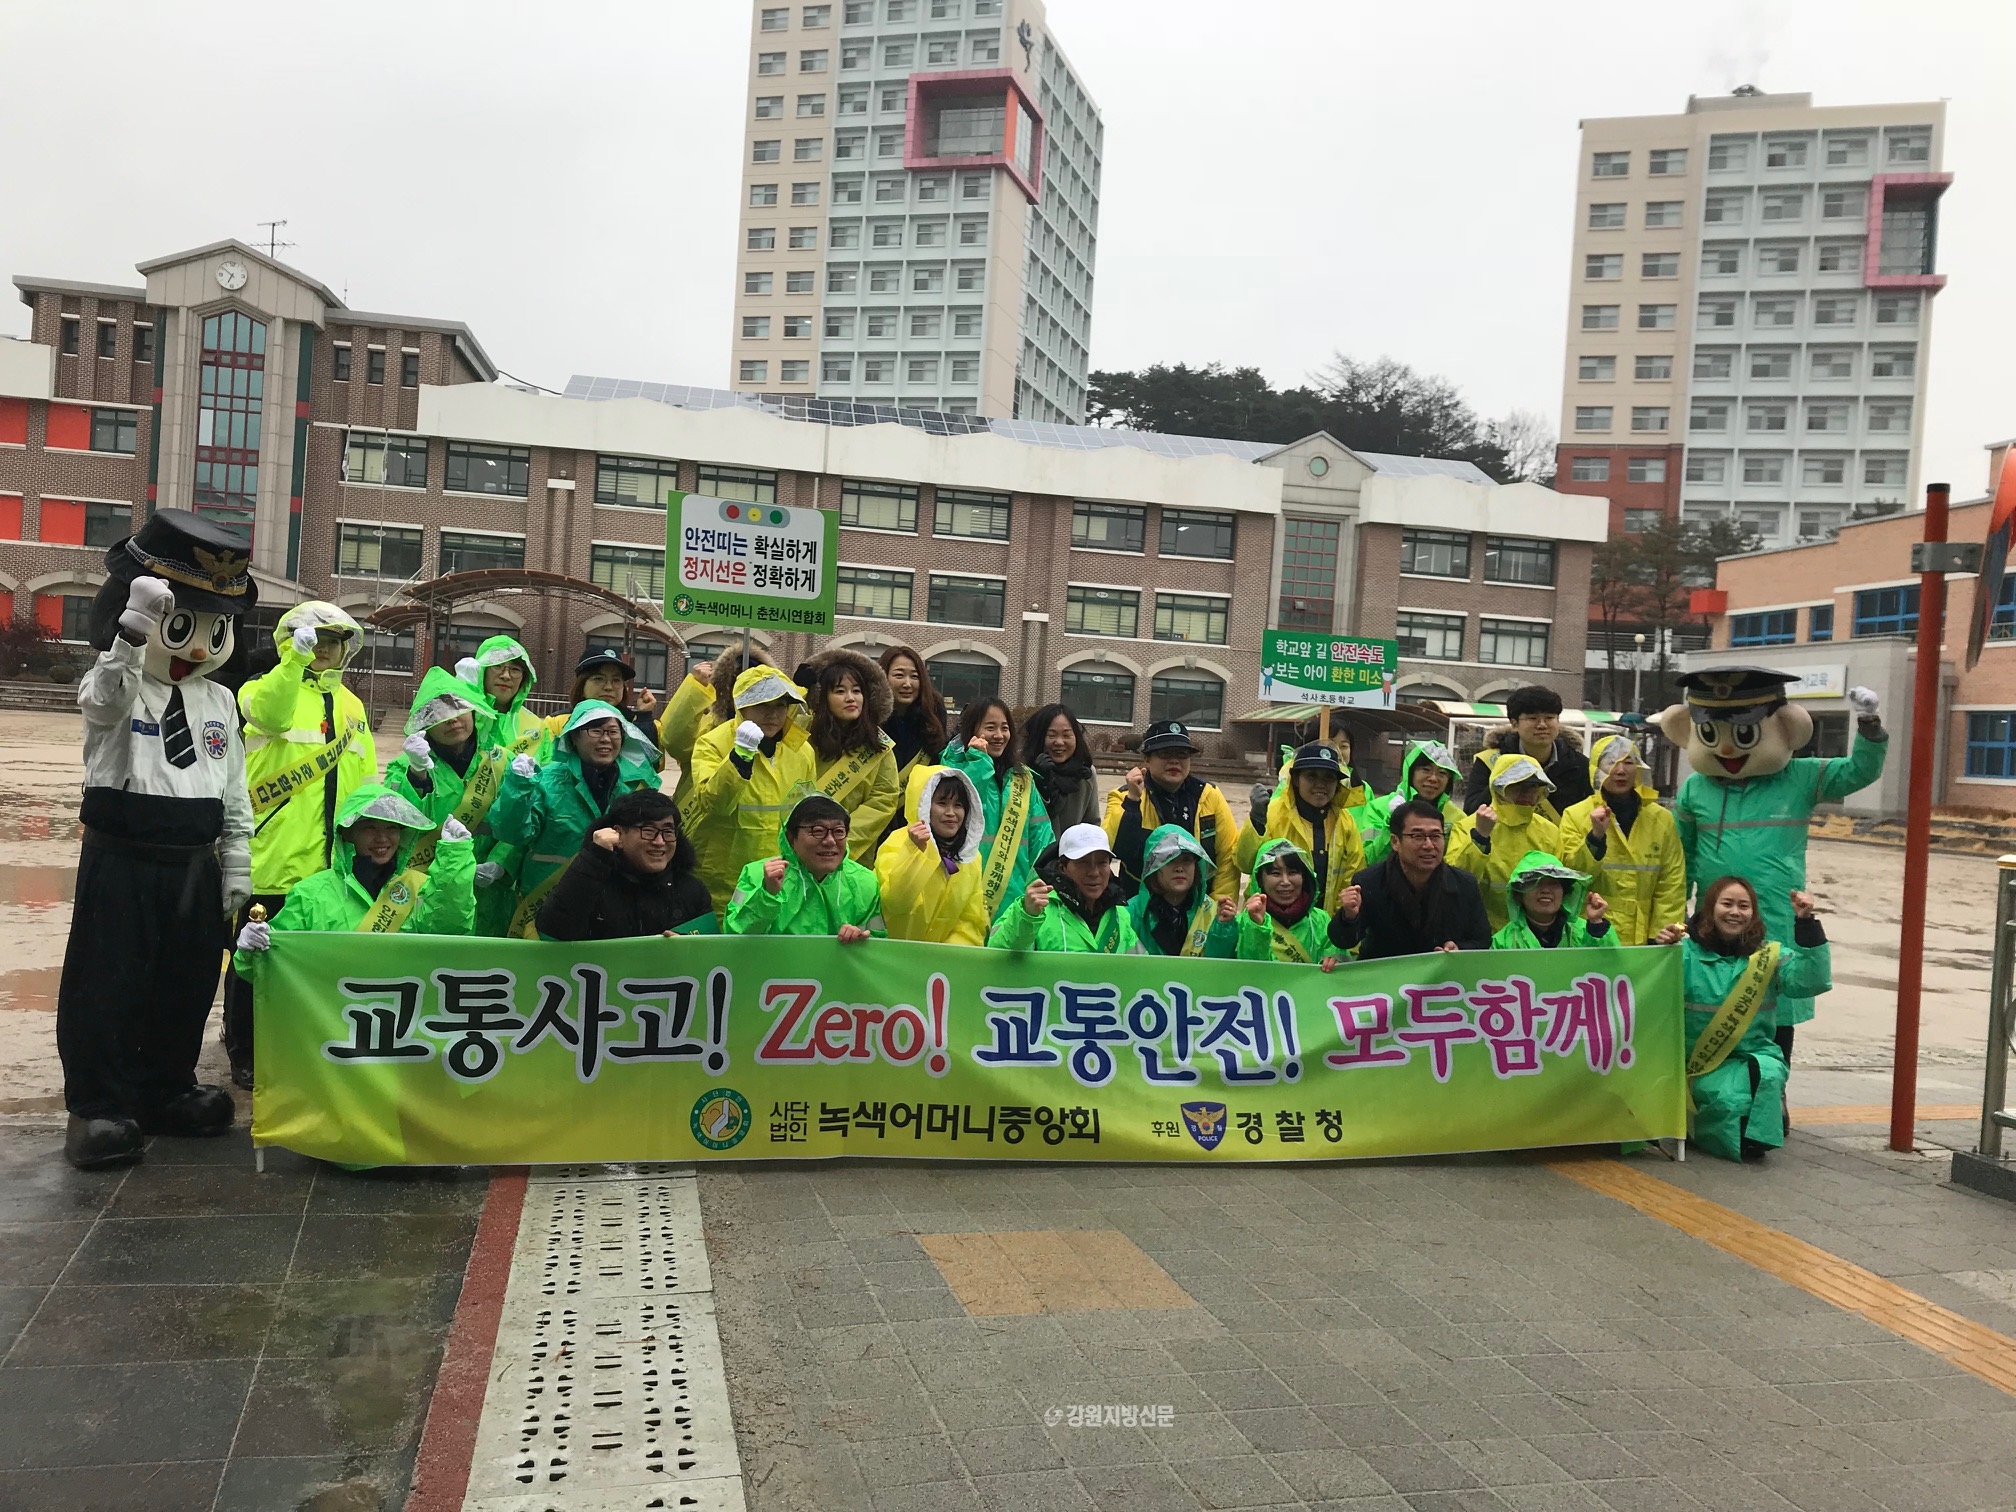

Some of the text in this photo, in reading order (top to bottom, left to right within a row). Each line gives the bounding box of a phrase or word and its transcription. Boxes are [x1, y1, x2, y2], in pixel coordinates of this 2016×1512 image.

[685, 527, 818, 564] 안전띠는 확실하게
[683, 556, 816, 592] 정지선은 정확하게
[695, 600, 826, 625] 녹색어머니 춘천시연합회
[1276, 639, 1385, 664] 학교앞 길 안전속도
[1275, 662, 1382, 686] 보는 아이 환한 미소
[1300, 692, 1355, 705] 석사초등학교
[255, 762, 315, 804] 준수합시다
[997, 807, 1021, 863] 녹색어머니와
[983, 861, 1007, 900] 함께해요
[325, 966, 1634, 1083] 교통사고! Zero! 교통안전! 모두함께!
[769, 1101, 810, 1121] 사단
[818, 1101, 1101, 1145] 녹색어머니중앙회
[1151, 1109, 1343, 1145] 후원 경찰청
[769, 1121, 808, 1142] 법인
